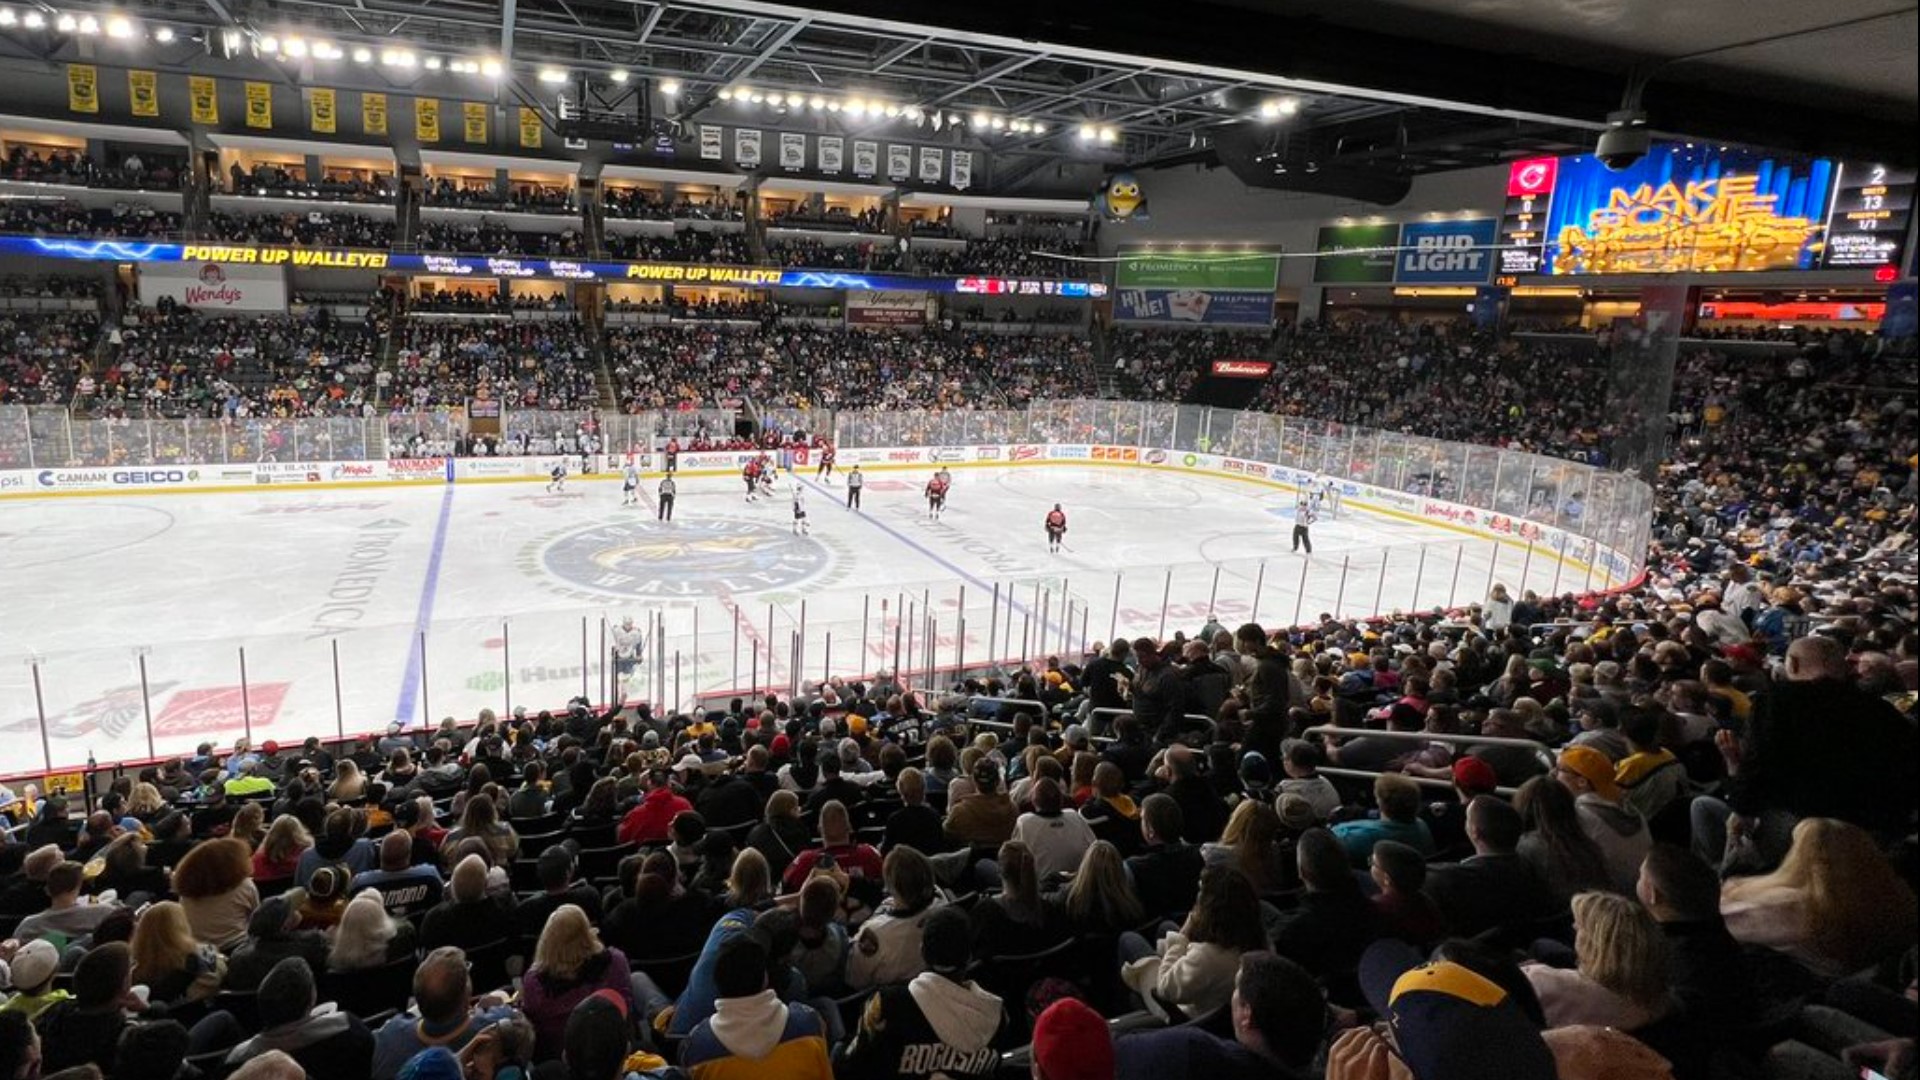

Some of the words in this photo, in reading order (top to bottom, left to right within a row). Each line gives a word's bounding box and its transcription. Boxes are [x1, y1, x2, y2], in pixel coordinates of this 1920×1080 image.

[1871, 168, 1886, 184] 2
[1610, 176, 1760, 209] MAKE
[1864, 195, 1882, 209] 13
[1417, 234, 1474, 253] BUD
[182, 246, 257, 263] POWER
[260, 248, 290, 263] UP
[292, 250, 388, 268] WALLEYE!
[1404, 252, 1484, 271] LIGHT
[627, 265, 684, 281] POWER
[686, 267, 708, 280] UP
[709, 270, 782, 284] WALLEYE!
[185, 285, 242, 304] Wendy's
[1120, 290, 1147, 308] HIT
[1134, 299, 1165, 318] ME!
[113, 470, 183, 484] GEICO
